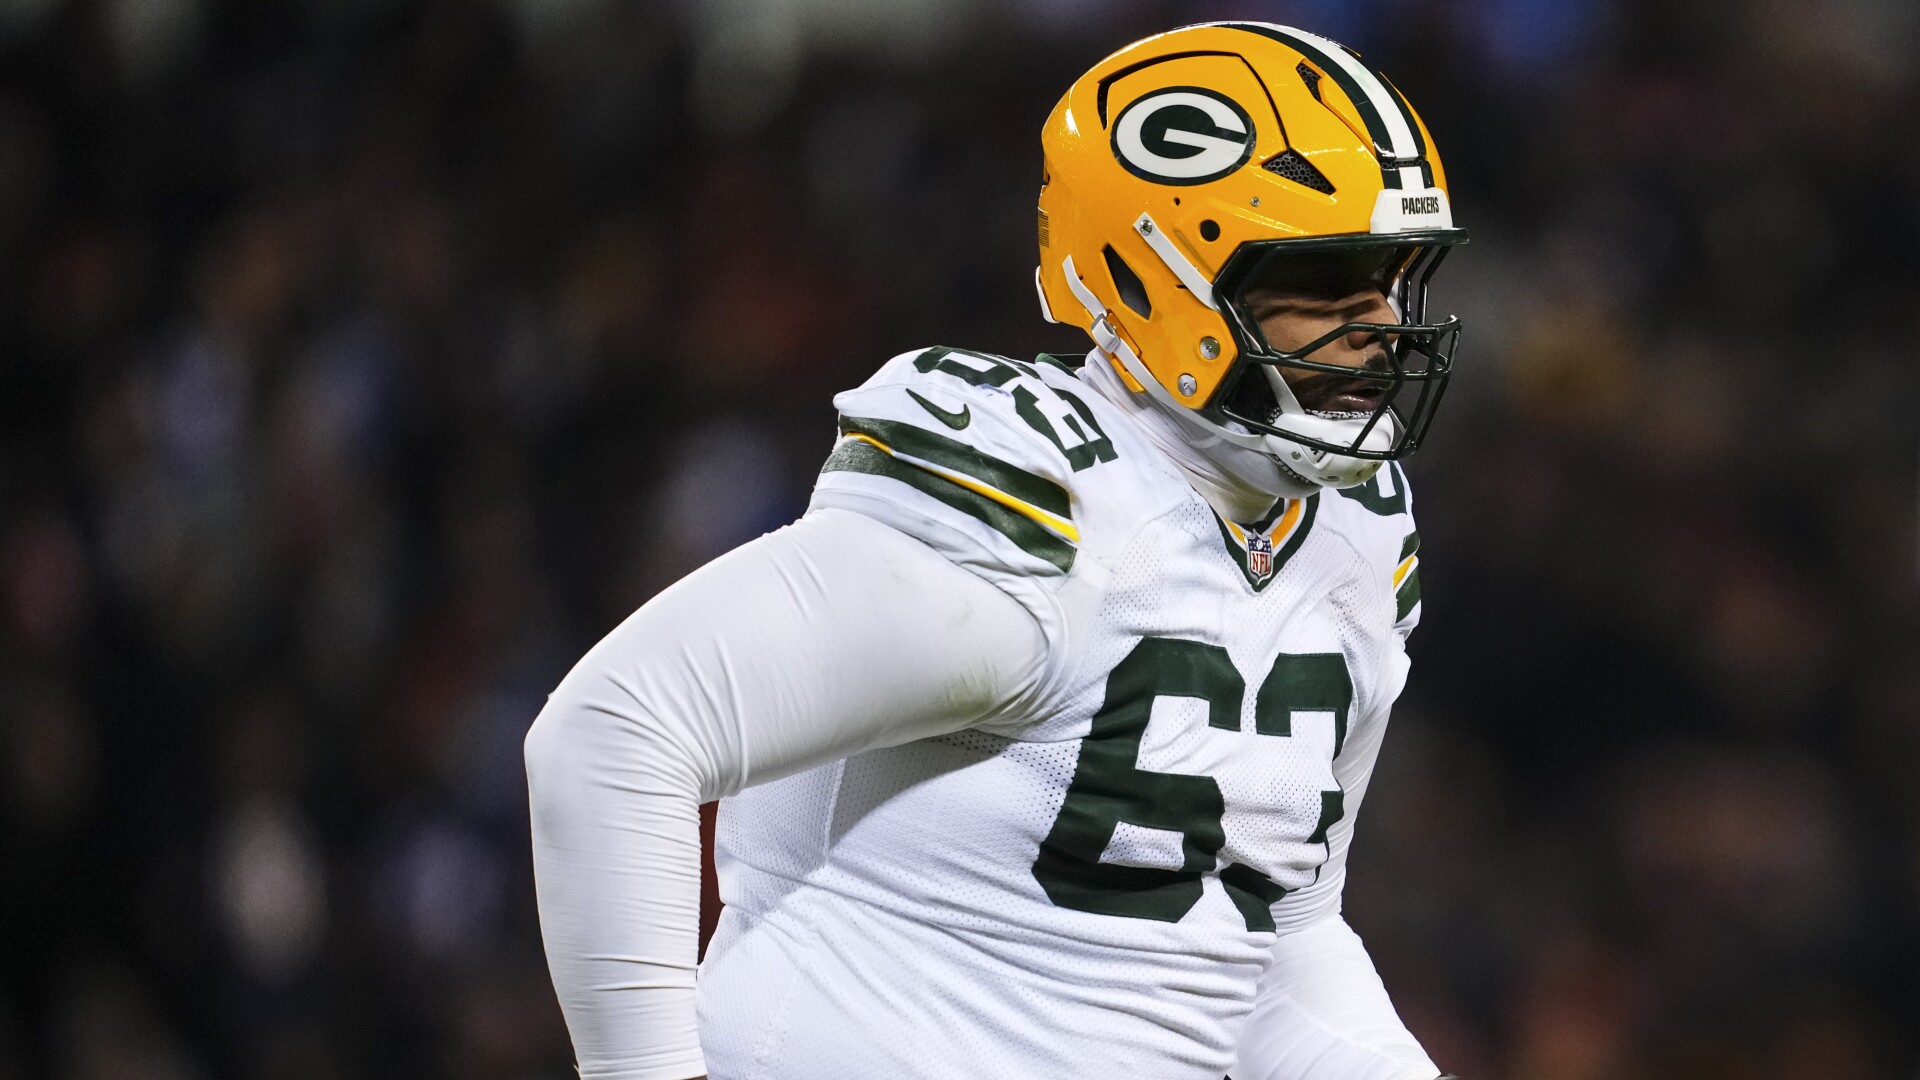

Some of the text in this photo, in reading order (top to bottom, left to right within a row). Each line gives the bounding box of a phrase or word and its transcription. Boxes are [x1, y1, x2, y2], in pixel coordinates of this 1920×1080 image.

[1116, 92, 1248, 178] G
[1401, 196, 1440, 215] PACKERS
[1252, 552, 1270, 574] NFL
[1031, 635, 1354, 933] 63
